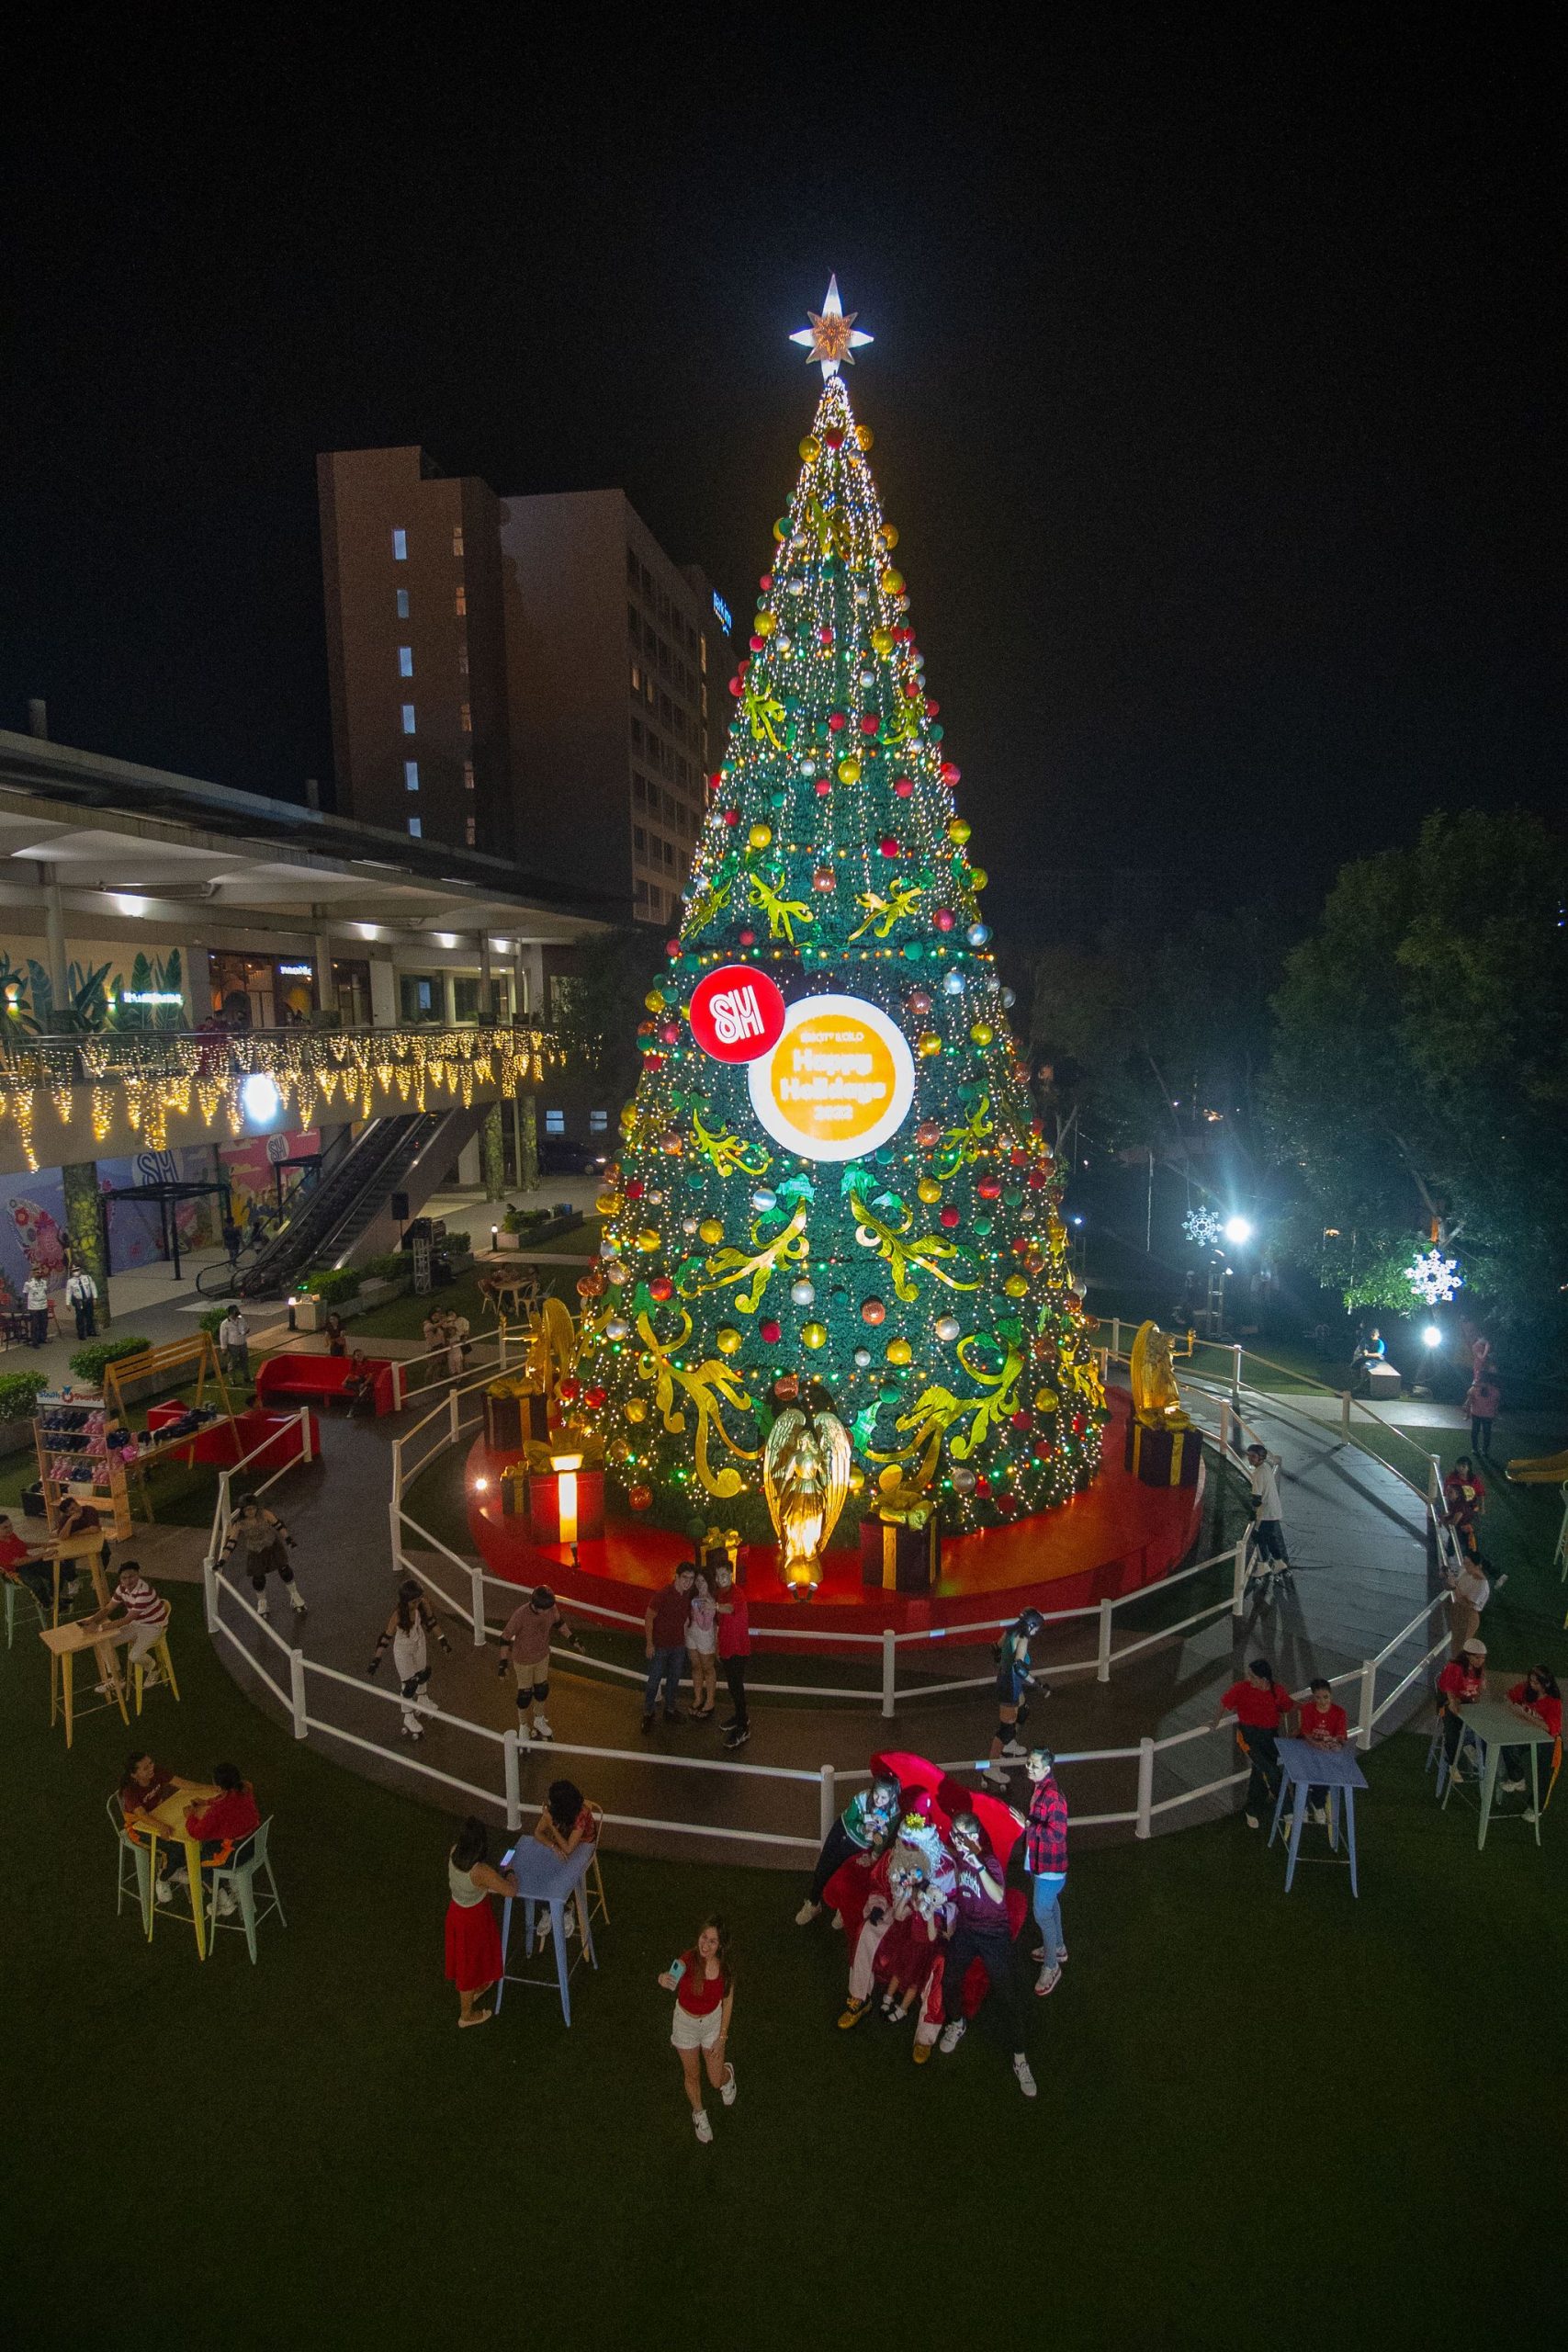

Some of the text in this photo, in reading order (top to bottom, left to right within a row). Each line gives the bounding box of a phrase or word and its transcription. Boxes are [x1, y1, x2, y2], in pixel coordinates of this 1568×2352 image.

[708, 984, 765, 1045] SM
[793, 1048, 873, 1076] Happy
[780, 1077, 886, 1103] Holidays
[267, 1135, 288, 1161] SM
